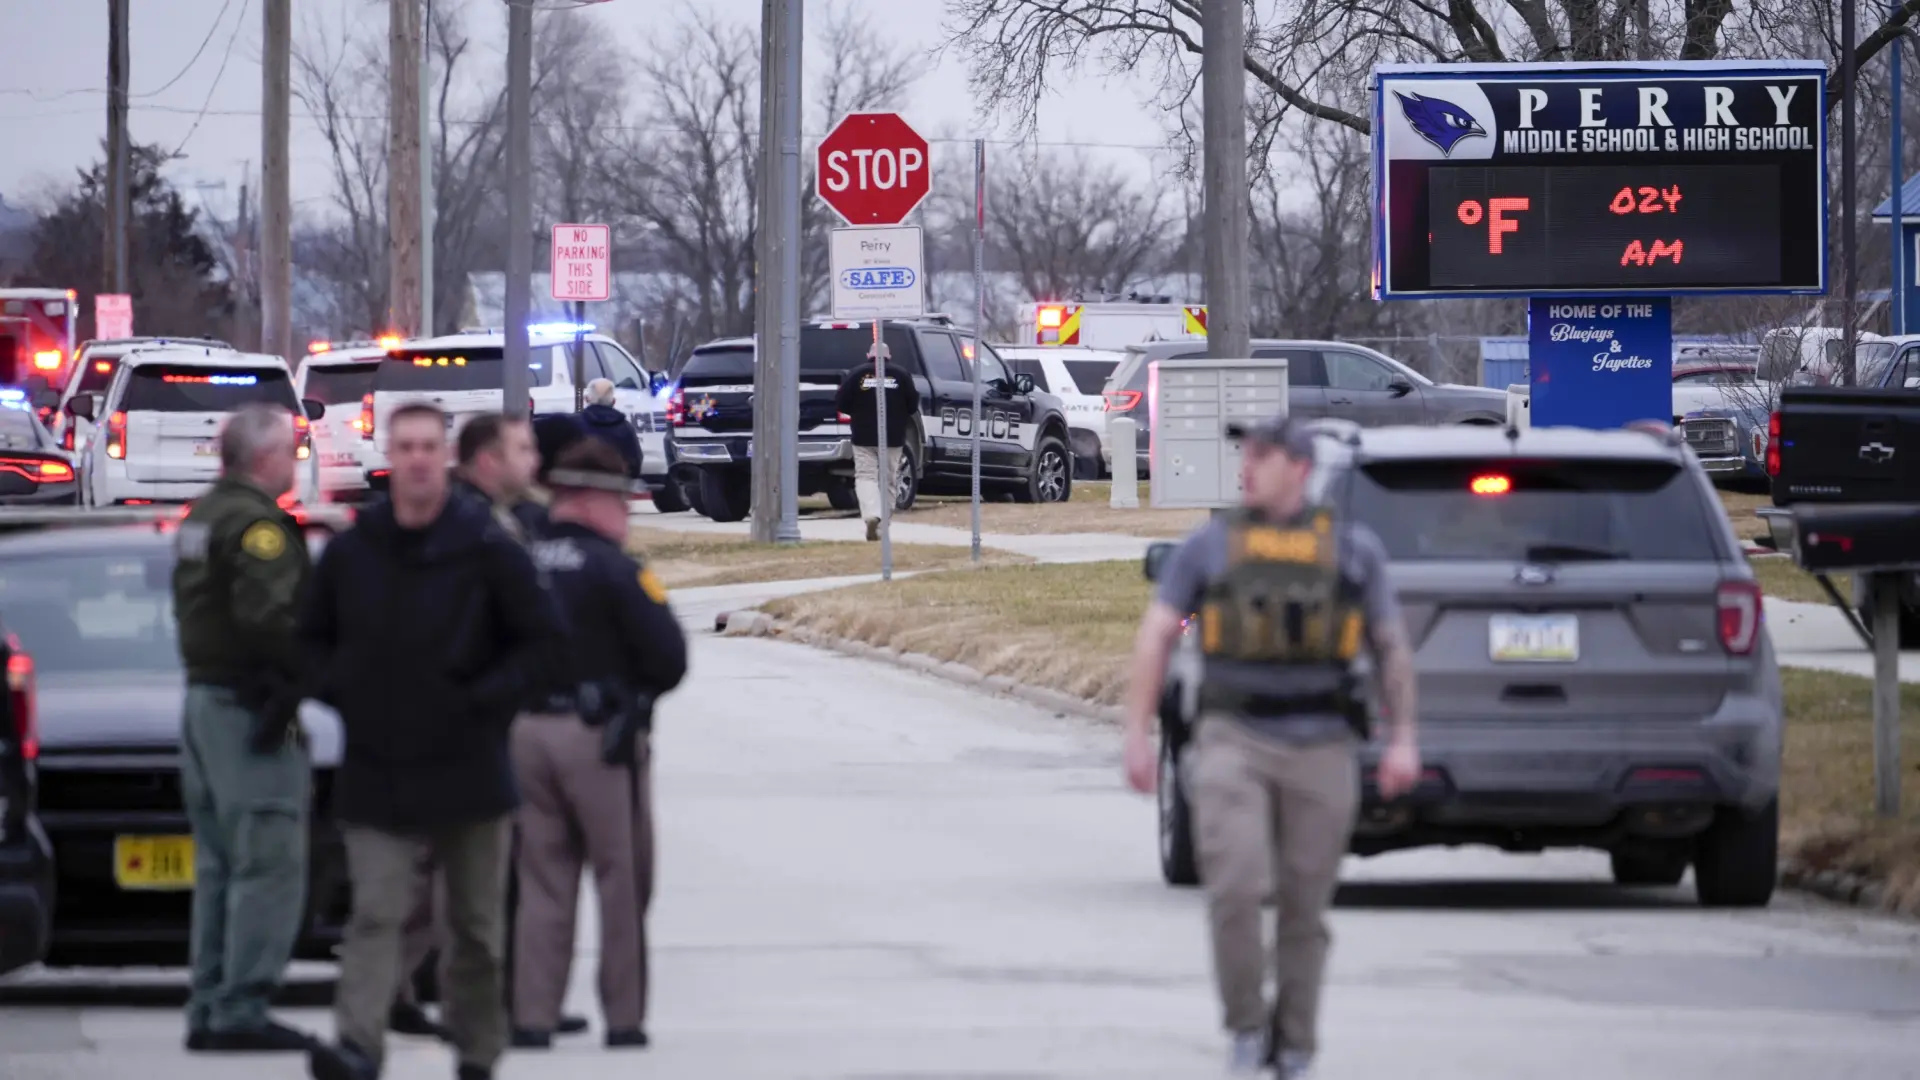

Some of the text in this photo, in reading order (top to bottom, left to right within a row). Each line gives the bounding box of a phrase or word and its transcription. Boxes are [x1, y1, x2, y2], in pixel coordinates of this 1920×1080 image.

[1518, 85, 1798, 128] PERRY
[1503, 126, 1813, 153] MIDDLE SCHOOL & HIGH SCHOOL
[826, 147, 923, 192] STOP
[1609, 185, 1682, 214] 024
[573, 229, 588, 243] NO
[557, 246, 605, 260] PARKING
[860, 241, 891, 252] Perry
[1621, 239, 1684, 266] AM
[568, 263, 593, 277] THIS
[850, 271, 904, 286] SAFE
[567, 280, 593, 295] SIDE
[1550, 304, 1653, 318] HOME OF THE
[1550, 323, 1615, 343] Bluejays
[1609, 340, 1622, 353] &
